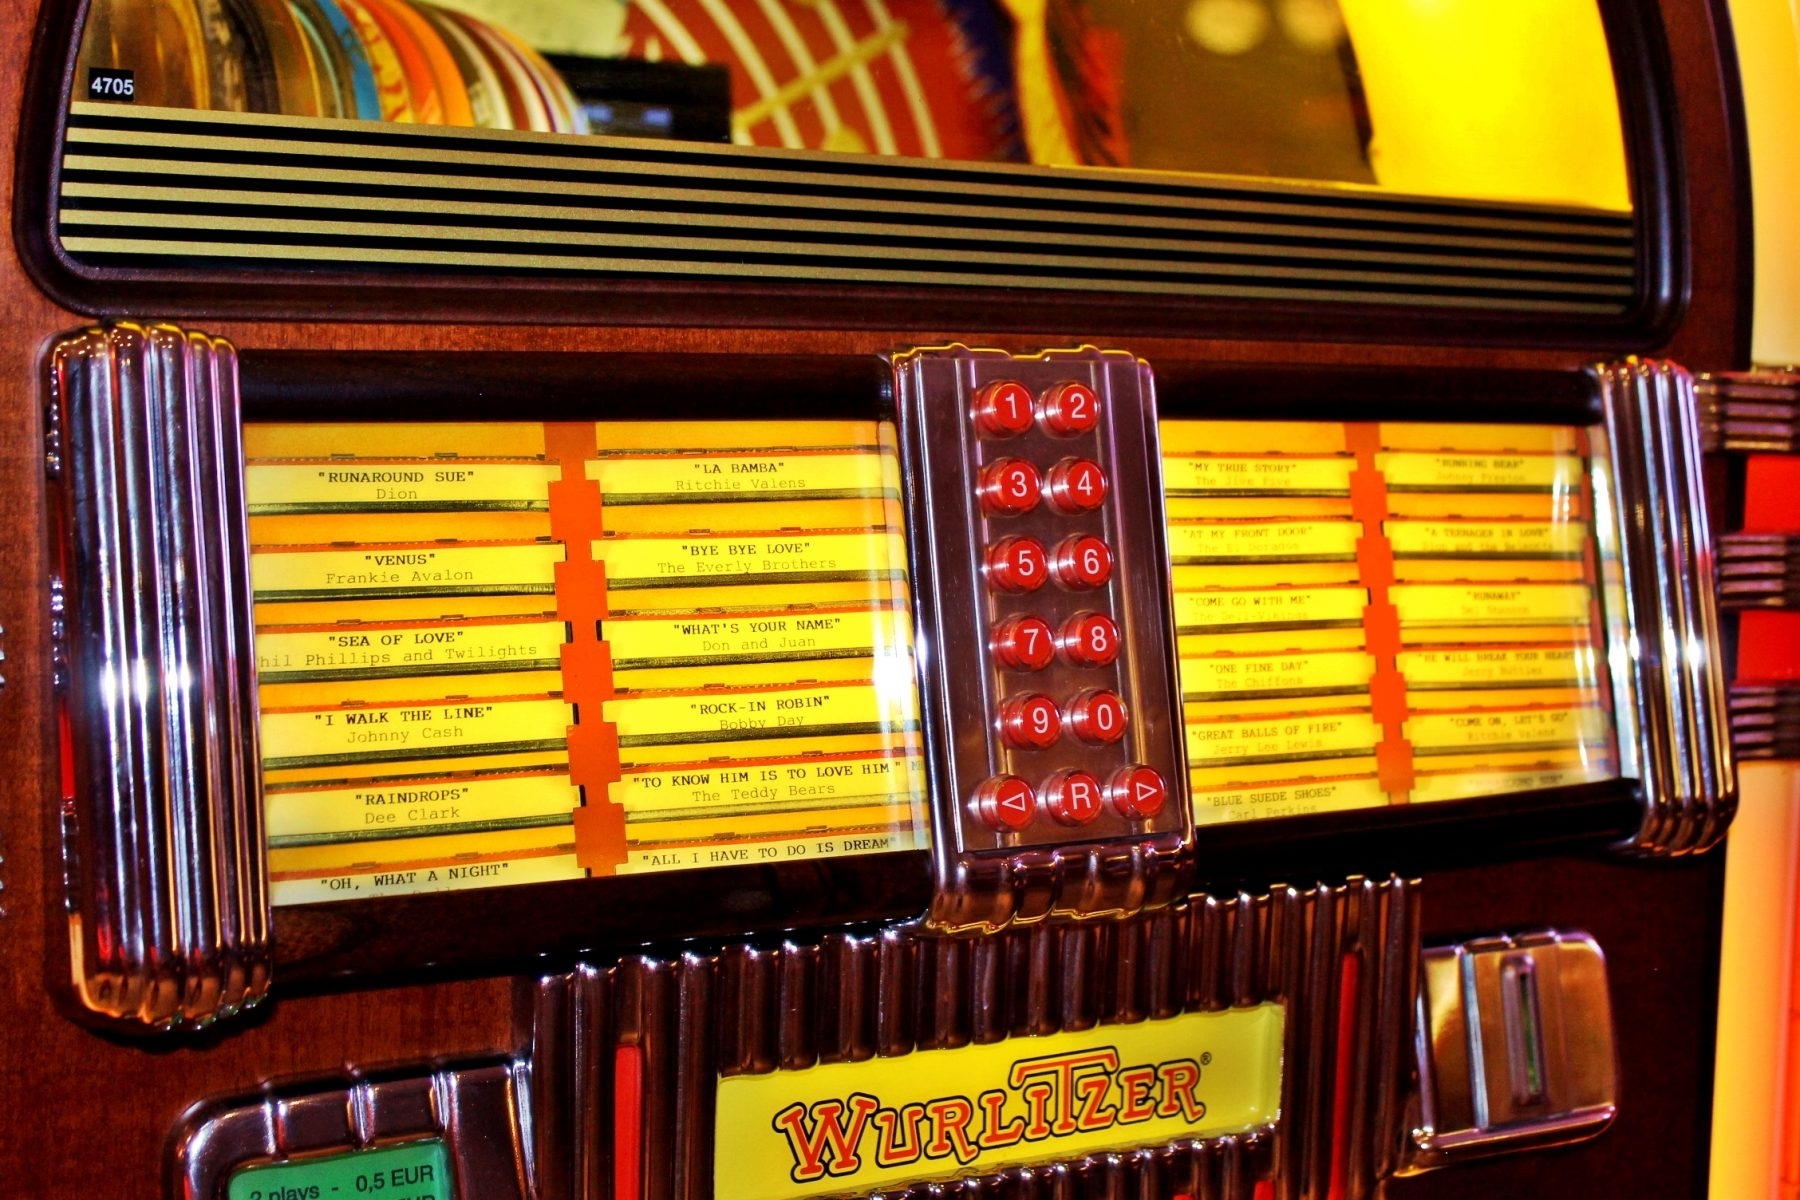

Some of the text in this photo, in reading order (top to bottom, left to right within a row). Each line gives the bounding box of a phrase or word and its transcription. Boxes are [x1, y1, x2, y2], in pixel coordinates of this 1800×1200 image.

[92, 77, 133, 95] 4705
[1006, 393, 1086, 419] 1 2
[695, 462, 784, 474] "LA BAMBA"
[1189, 462, 1296, 473] "MY TRUE STORY"
[319, 471, 474, 483] "RUNAROUND SUE"
[676, 478, 805, 490] Ritchie Valens
[1011, 471, 1092, 497] 3 4
[377, 488, 417, 500] Dion
[1184, 526, 1312, 538] "AT MY FRONT DOOR"
[682, 543, 810, 556] "BYE BYE LOVE"
[365, 554, 435, 565] "VENUS"
[658, 558, 836, 573] The Everly Brothers
[1018, 549, 1099, 576] 5 6
[327, 570, 473, 584] Frankie Avalon
[1190, 595, 1310, 606] "COME GO WITH ME"
[674, 618, 840, 635] "WHAT'S YOUR NAME"
[329, 631, 464, 647] "SEA OF LOVE"
[703, 636, 815, 651] Don and Juan
[1024, 626, 1107, 655] 7 8
[259, 645, 536, 666] hil Phillips and Twilights
[1210, 661, 1309, 673] "ONE FINE DAY"
[1217, 677, 1303, 688] The Chiffons
[691, 696, 829, 714] "ROCK-IN ROBIN"
[315, 707, 492, 726] "I WALK THE LINE"
[720, 714, 803, 730] Bobby Day
[1032, 704, 1112, 733] 9 0
[348, 727, 463, 744] Johnny Cash
[1192, 722, 1342, 741] "GREAT BALLS OF FIRE"
[634, 777, 661, 789] "TO
[672, 773, 709, 786] KNOW
[721, 772, 748, 783] HIM
[761, 770, 777, 781] IS
[787, 768, 806, 779] TO
[816, 765, 852, 777] LOVE
[356, 788, 468, 805] "RAINDROPS"
[692, 784, 835, 802] The Teddy Bears
[1071, 783, 1092, 809] R
[1207, 787, 1336, 806] "BLUE SUEDE SHOES"
[365, 807, 460, 824] Dee Clark
[643, 855, 680, 866] "ALL
[692, 852, 698, 863] I
[710, 849, 748, 861] HAVE
[759, 848, 777, 858] TO
[787, 845, 806, 856] DO
[816, 843, 833, 853] IS
[321, 864, 509, 890] "OH, WHAT A NIGHT"
[356, 1175, 385, 1193] 0,5
[391, 1165, 434, 1187] EUR
